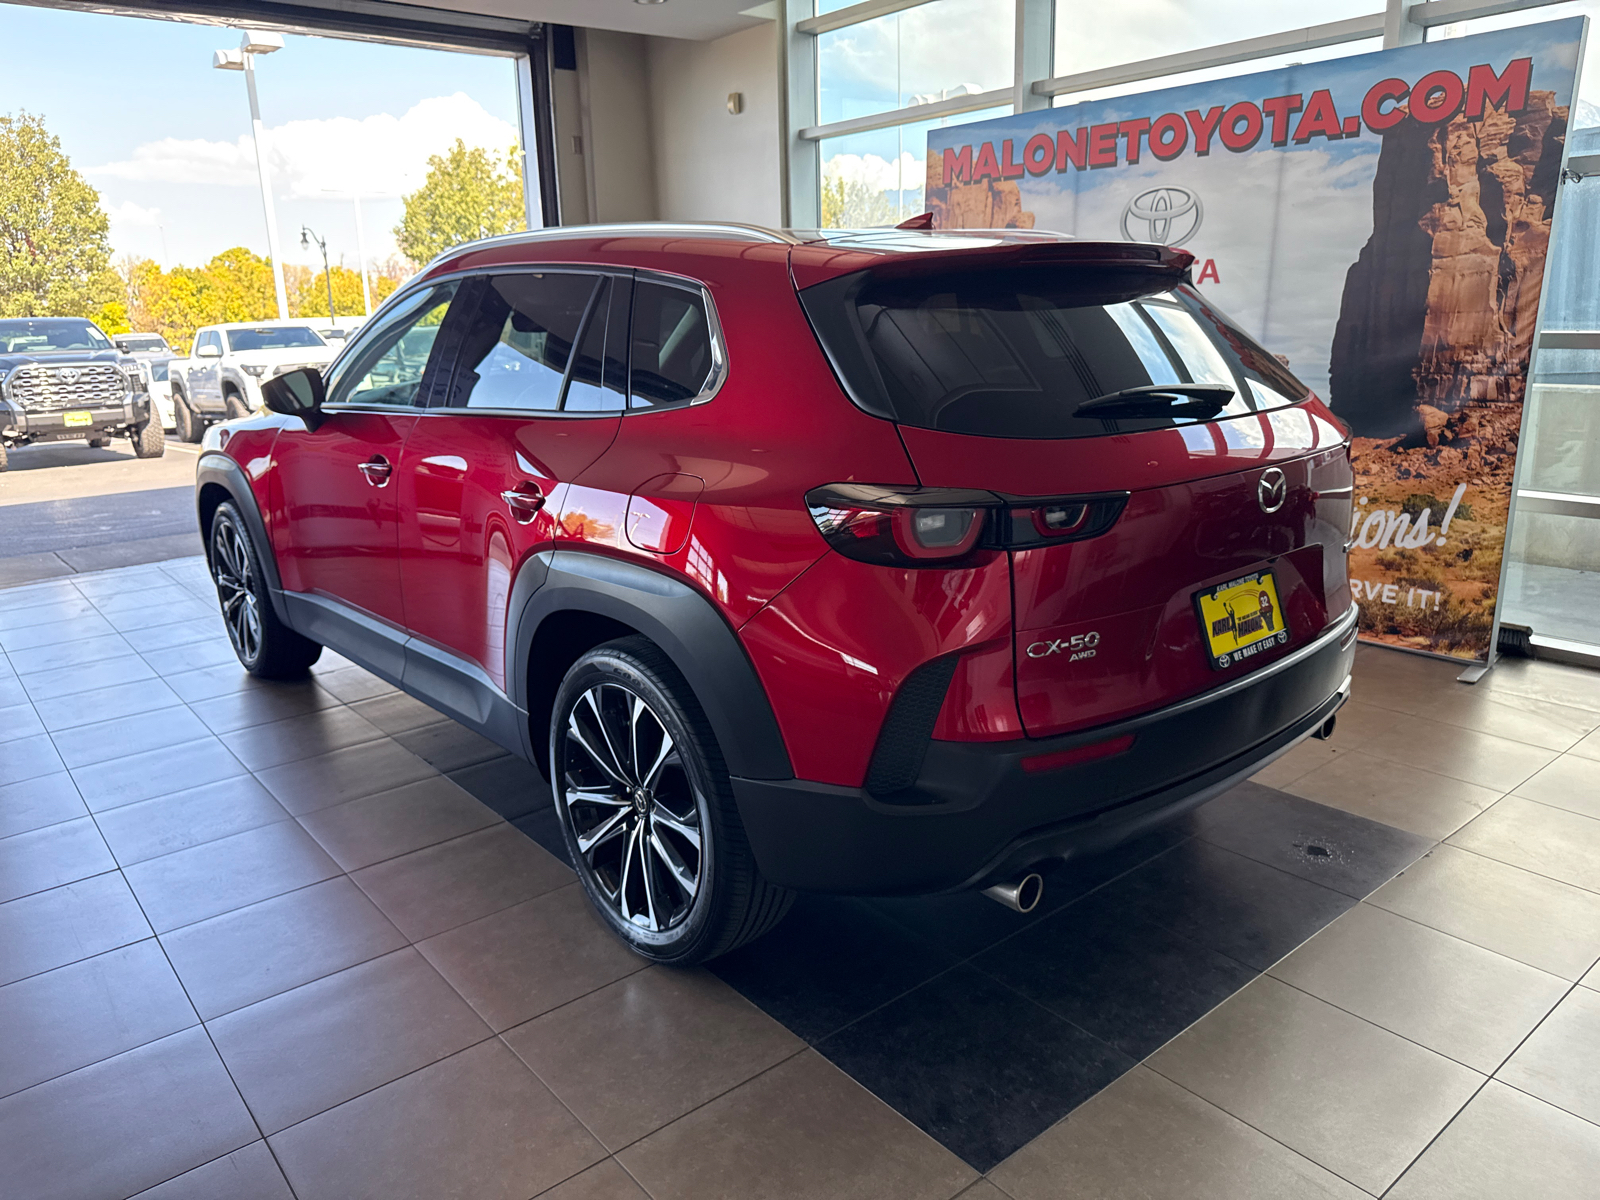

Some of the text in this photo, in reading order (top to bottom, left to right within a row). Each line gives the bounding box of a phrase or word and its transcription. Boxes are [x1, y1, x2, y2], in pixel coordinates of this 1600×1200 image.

[942, 58, 1533, 185] MALONETOYOTA.COM
[1350, 483, 1467, 549] ions!
[1260, 595, 1269, 607] 32
[1407, 587, 1441, 611] IT!
[1212, 616, 1232, 638] KARL
[1237, 616, 1264, 639] MALONE
[1026, 631, 1100, 658] CX-50
[1068, 649, 1097, 663] AWD
[1233, 637, 1275, 662] WE MAKE IT EASY
